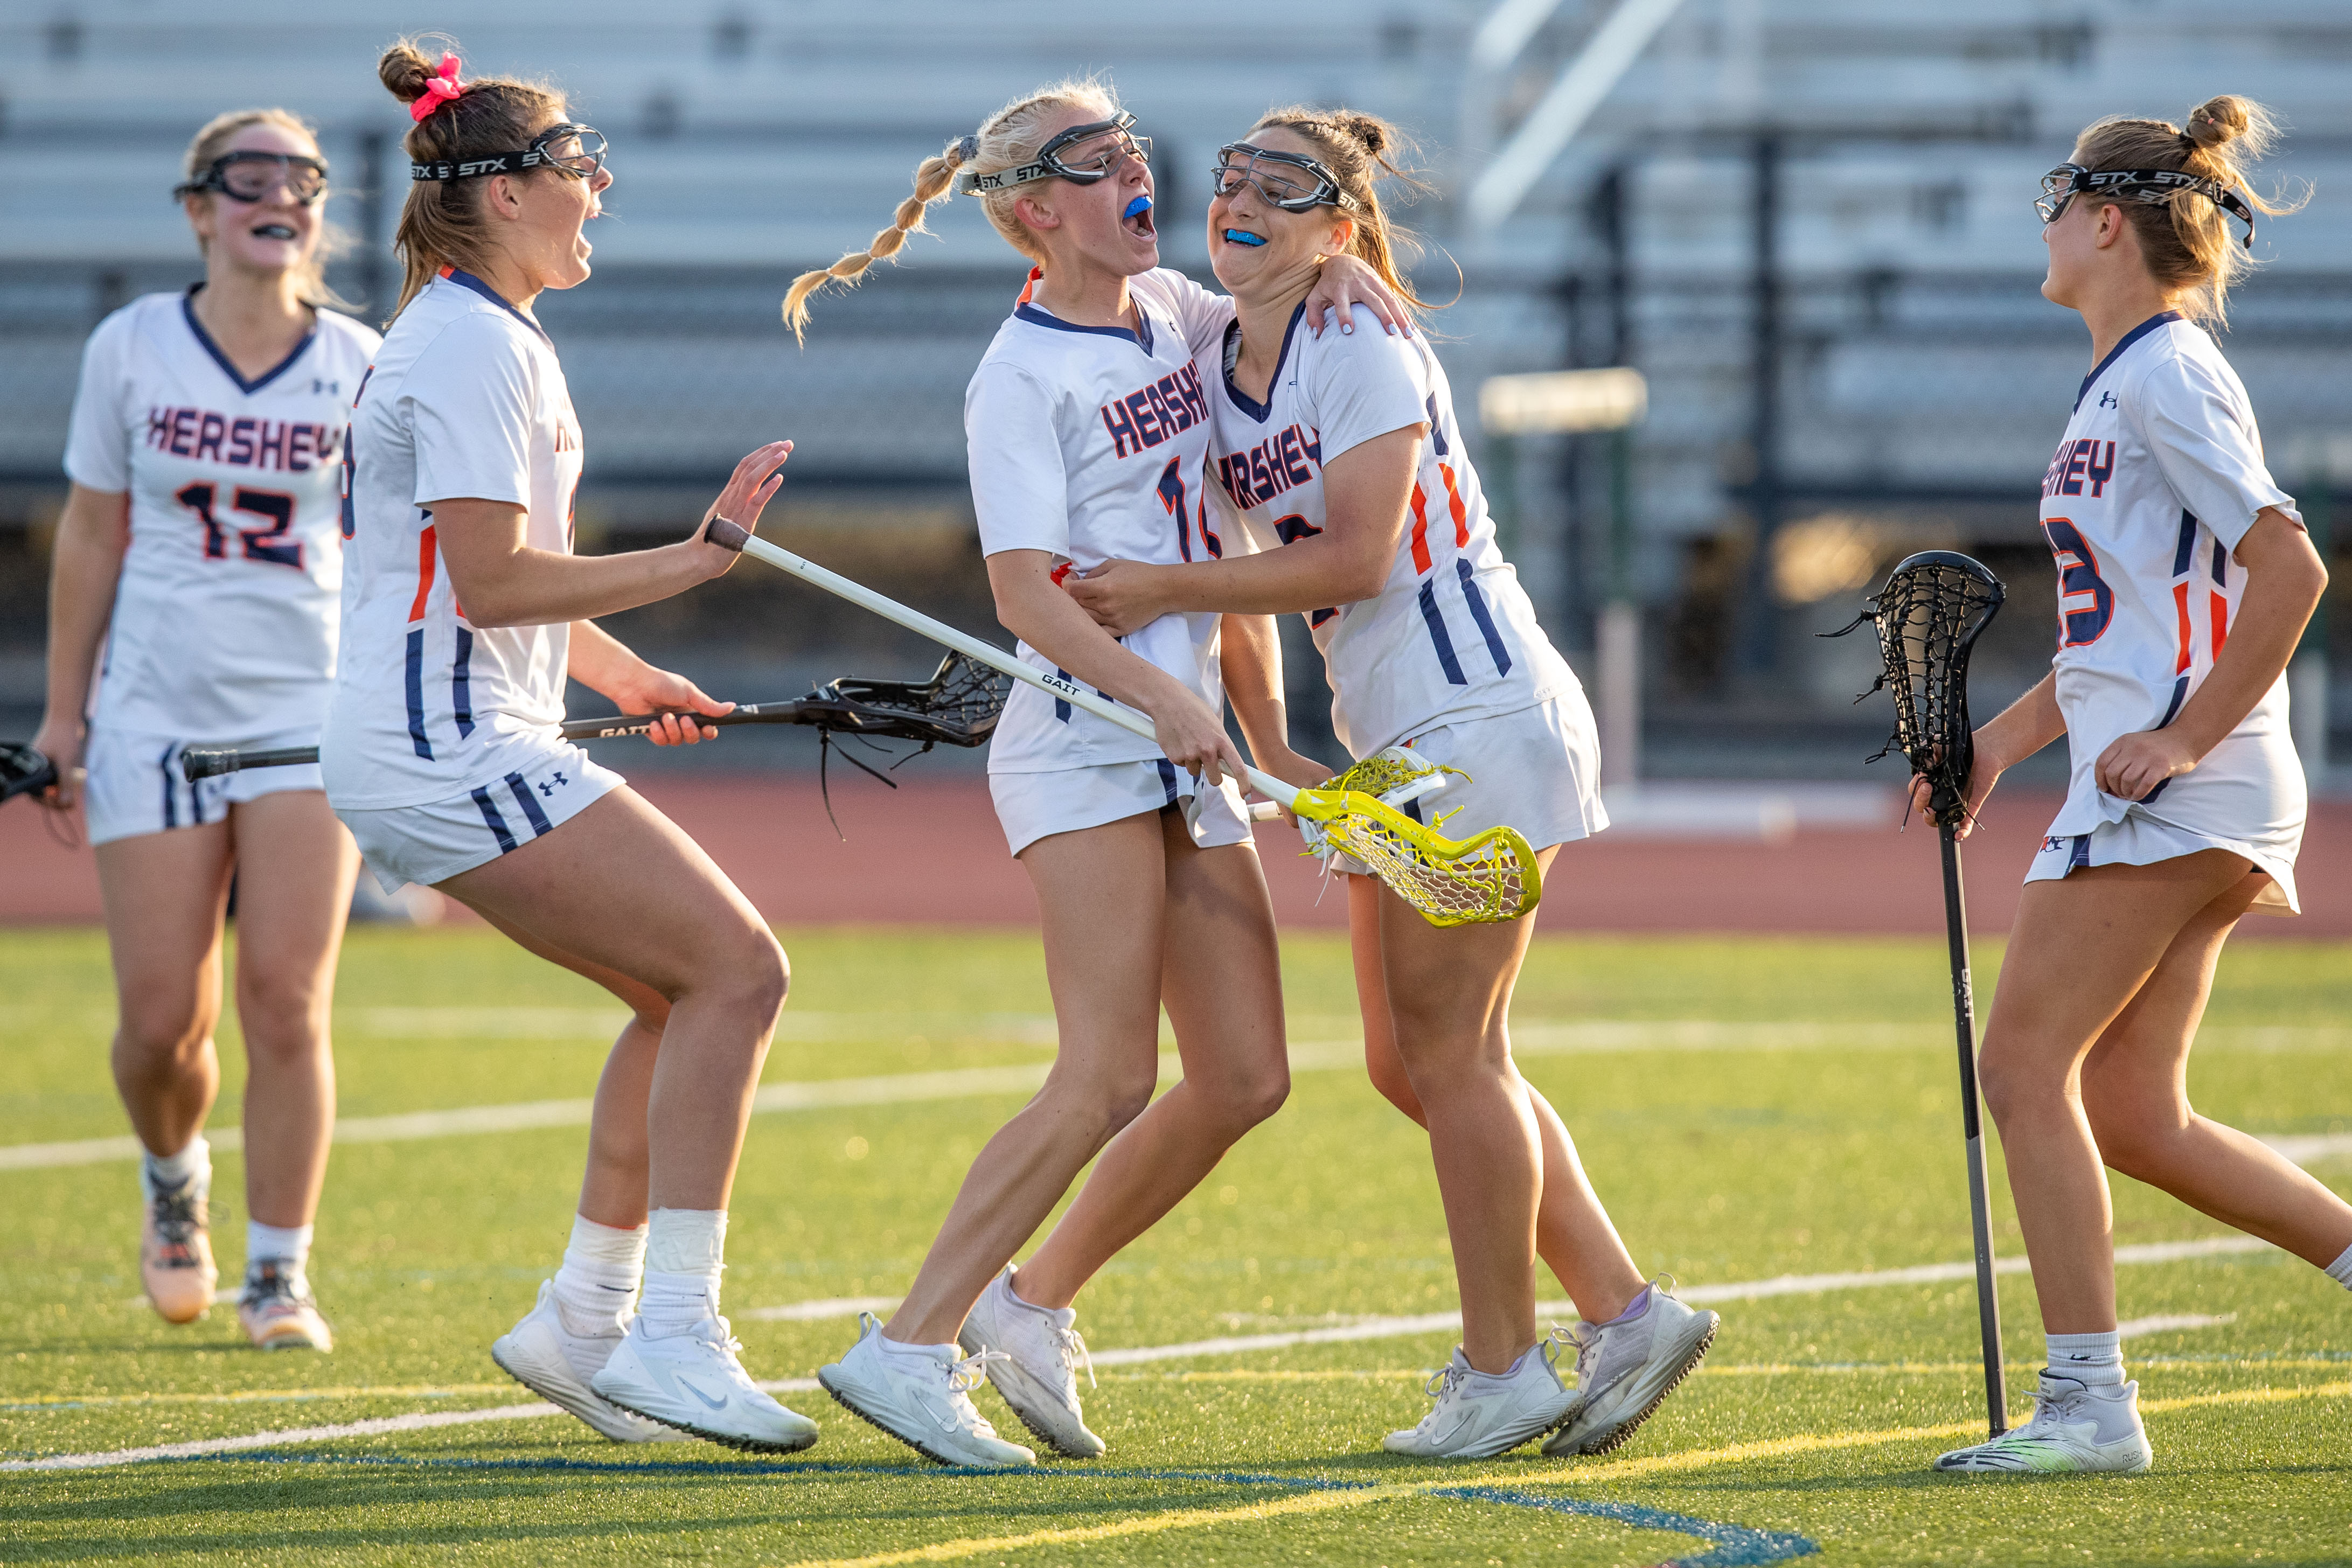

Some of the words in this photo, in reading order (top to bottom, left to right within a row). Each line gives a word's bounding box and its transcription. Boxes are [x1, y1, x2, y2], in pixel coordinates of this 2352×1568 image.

[458, 158, 507, 176] STX
[2089, 171, 2138, 185] STX
[2154, 171, 2198, 189] STX
[1339, 192, 1359, 212] STX
[1101, 358, 1209, 459] HERSH
[148, 405, 340, 472] HERSHEY
[1218, 423, 1323, 510] RSHEY
[176, 480, 304, 571] 12
[1042, 674, 1081, 695] GAIT
[1961, 968, 1974, 1022] GAIT
[2123, 1449, 2142, 1464] RUSH
